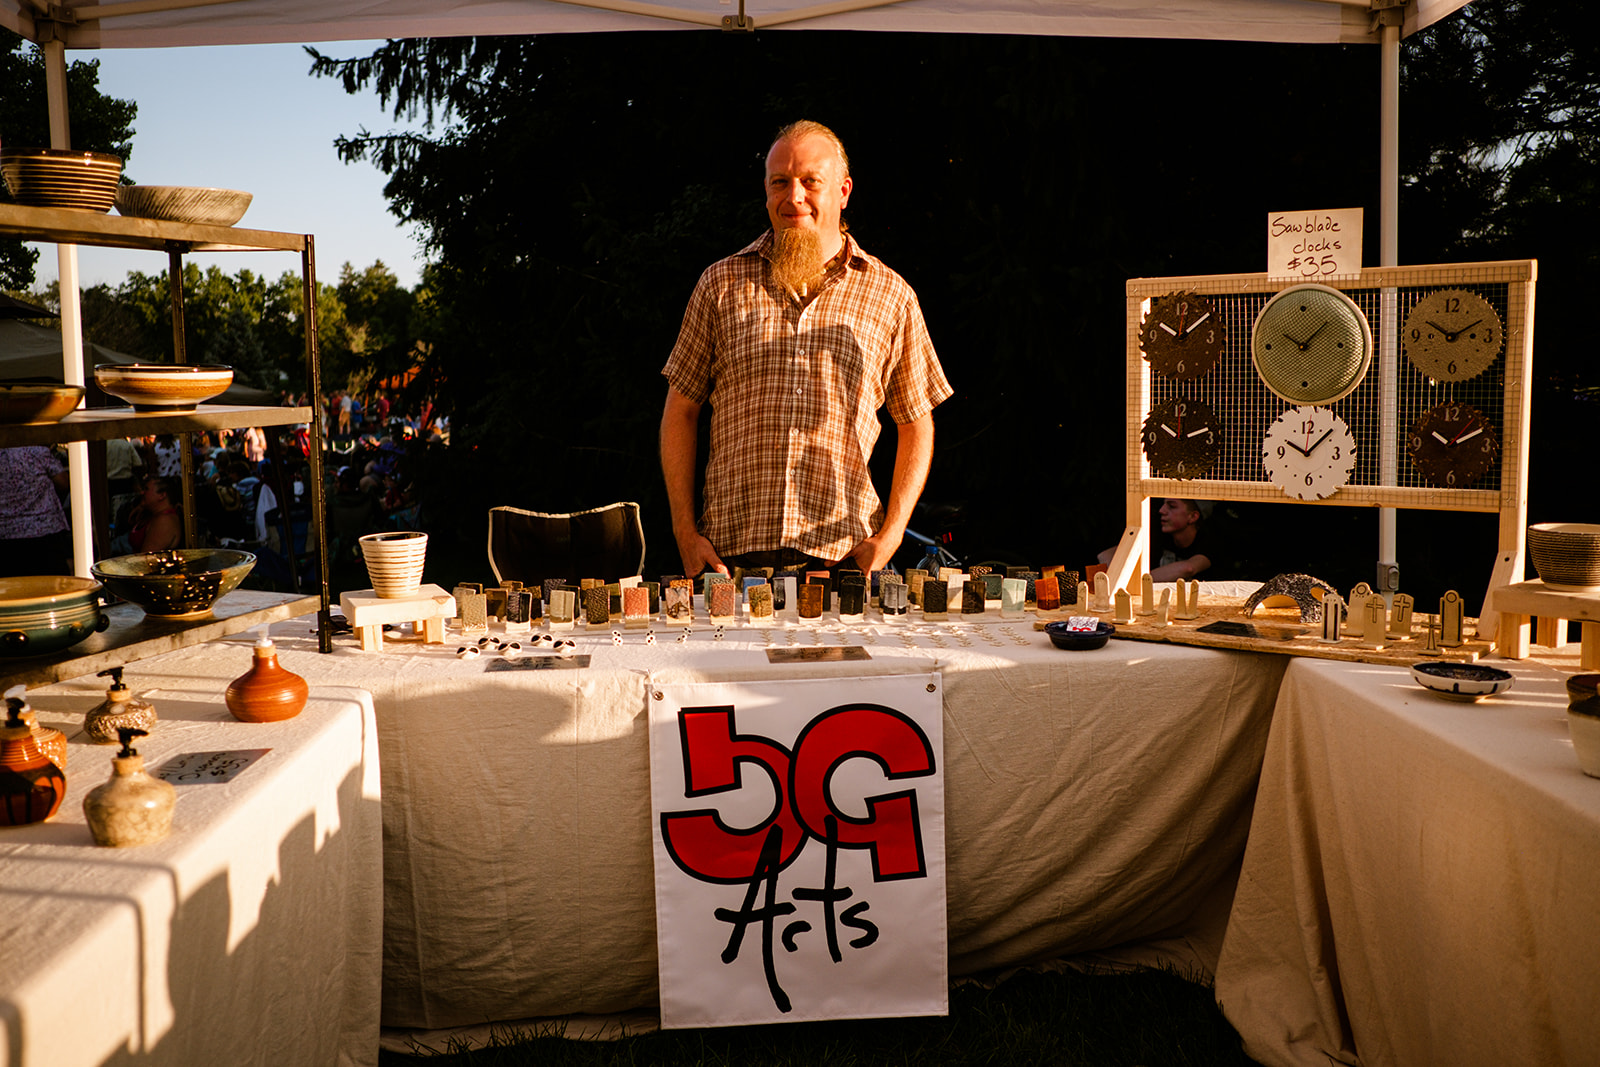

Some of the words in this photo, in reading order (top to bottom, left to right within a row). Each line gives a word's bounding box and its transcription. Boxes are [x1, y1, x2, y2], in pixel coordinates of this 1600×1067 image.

[1293, 237, 1341, 254] clocks
[1287, 254, 1337, 276] $35
[1176, 302, 1188, 315] 12
[1445, 298, 1460, 313] 12
[1150, 329, 1157, 343] 9
[1206, 330, 1214, 344] 3
[1412, 329, 1420, 343] 9
[1484, 328, 1492, 343] 3
[1177, 360, 1185, 373] 6
[1448, 360, 1456, 374] 6
[1175, 404, 1186, 417] 12
[1445, 407, 1460, 421] 12
[1302, 420, 1314, 434] 12
[1149, 432, 1156, 445] 9
[1206, 431, 1214, 444] 3
[1413, 437, 1421, 451] 9
[1481, 438, 1490, 452] 3
[1277, 446, 1285, 459] 9
[1332, 446, 1340, 460] 3
[1177, 460, 1185, 473] 6
[1305, 472, 1313, 486] 6
[1447, 470, 1455, 485] 6
